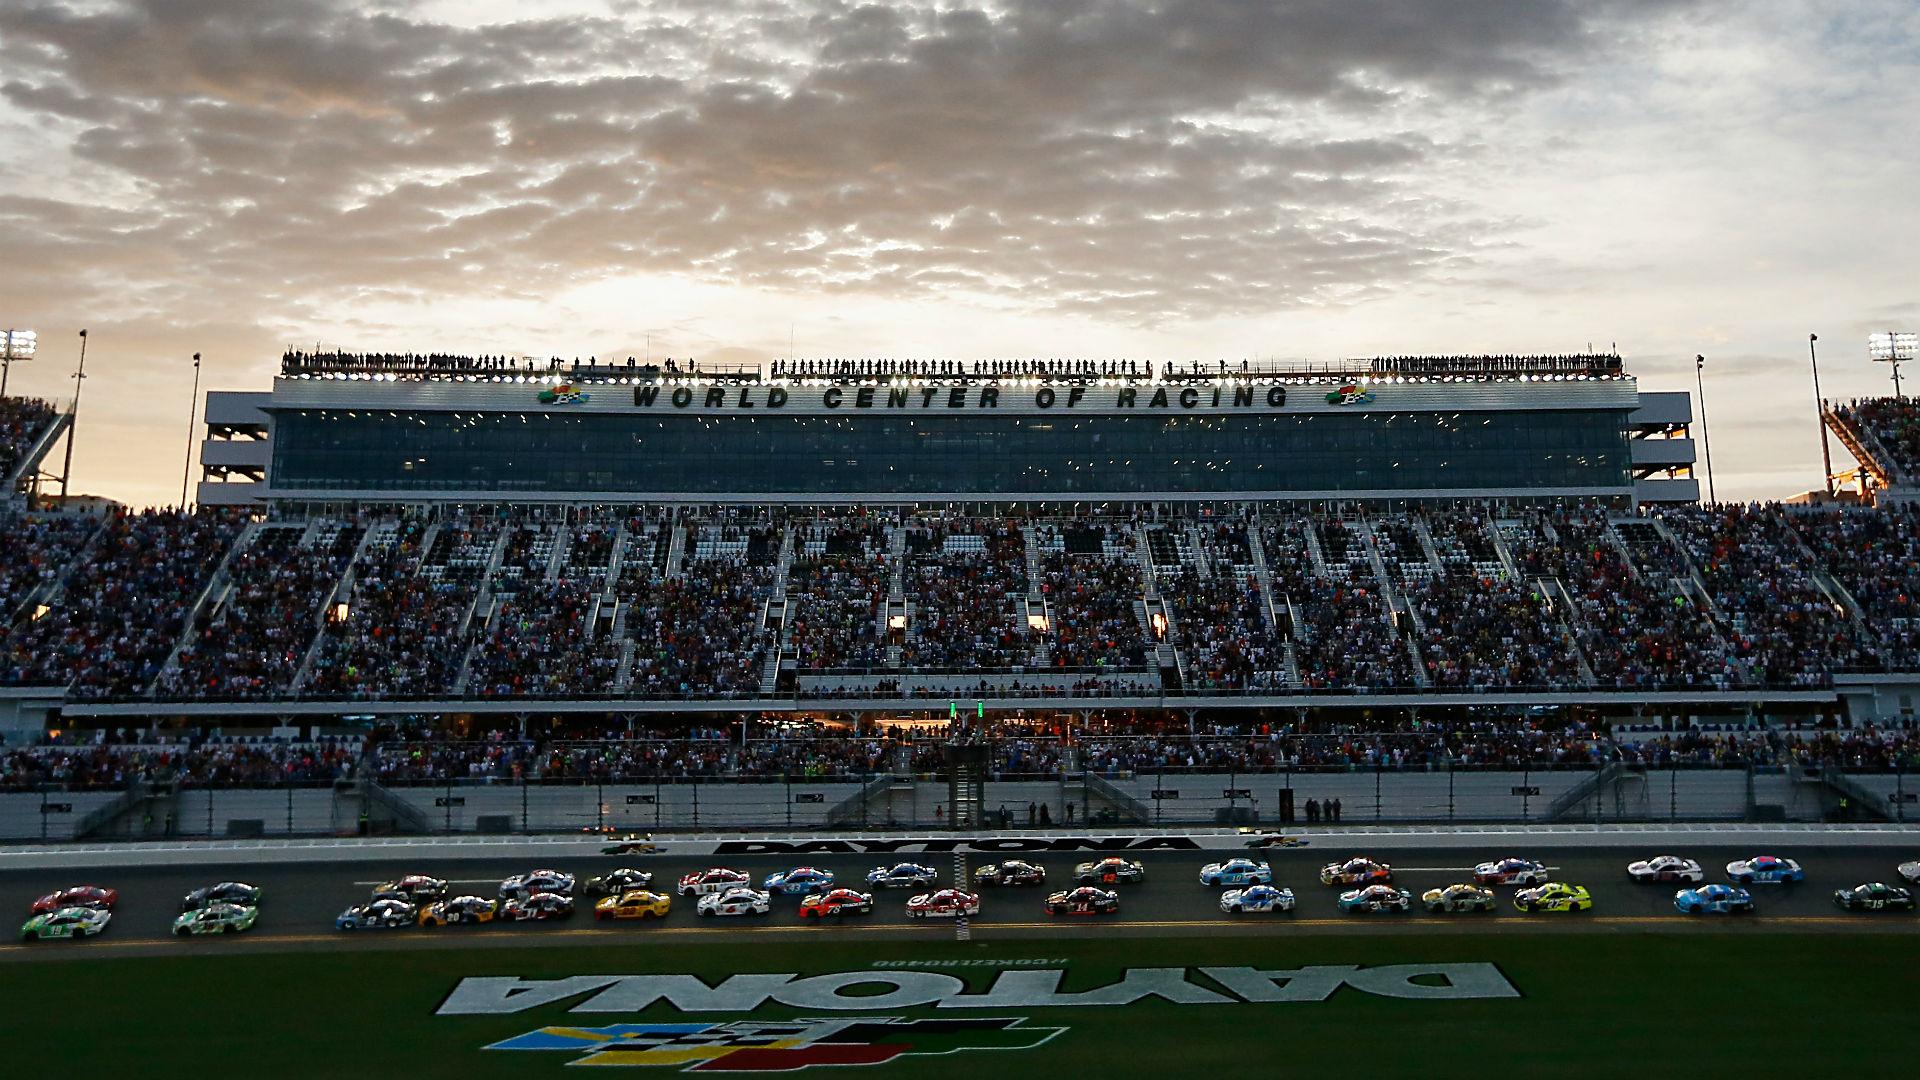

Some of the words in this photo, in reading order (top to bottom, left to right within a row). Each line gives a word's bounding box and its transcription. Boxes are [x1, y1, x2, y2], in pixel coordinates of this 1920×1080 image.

[633, 386, 788, 409] WORLD
[822, 387, 1002, 409] CENTER
[1035, 387, 1085, 409] OF
[1116, 387, 1288, 409] RACING
[713, 838, 1202, 855] DAYTONA
[827, 905, 841, 914] 78
[1076, 903, 1089, 912] 14
[447, 912, 460, 923] 20
[434, 961, 1522, 1016] DAYTONA
